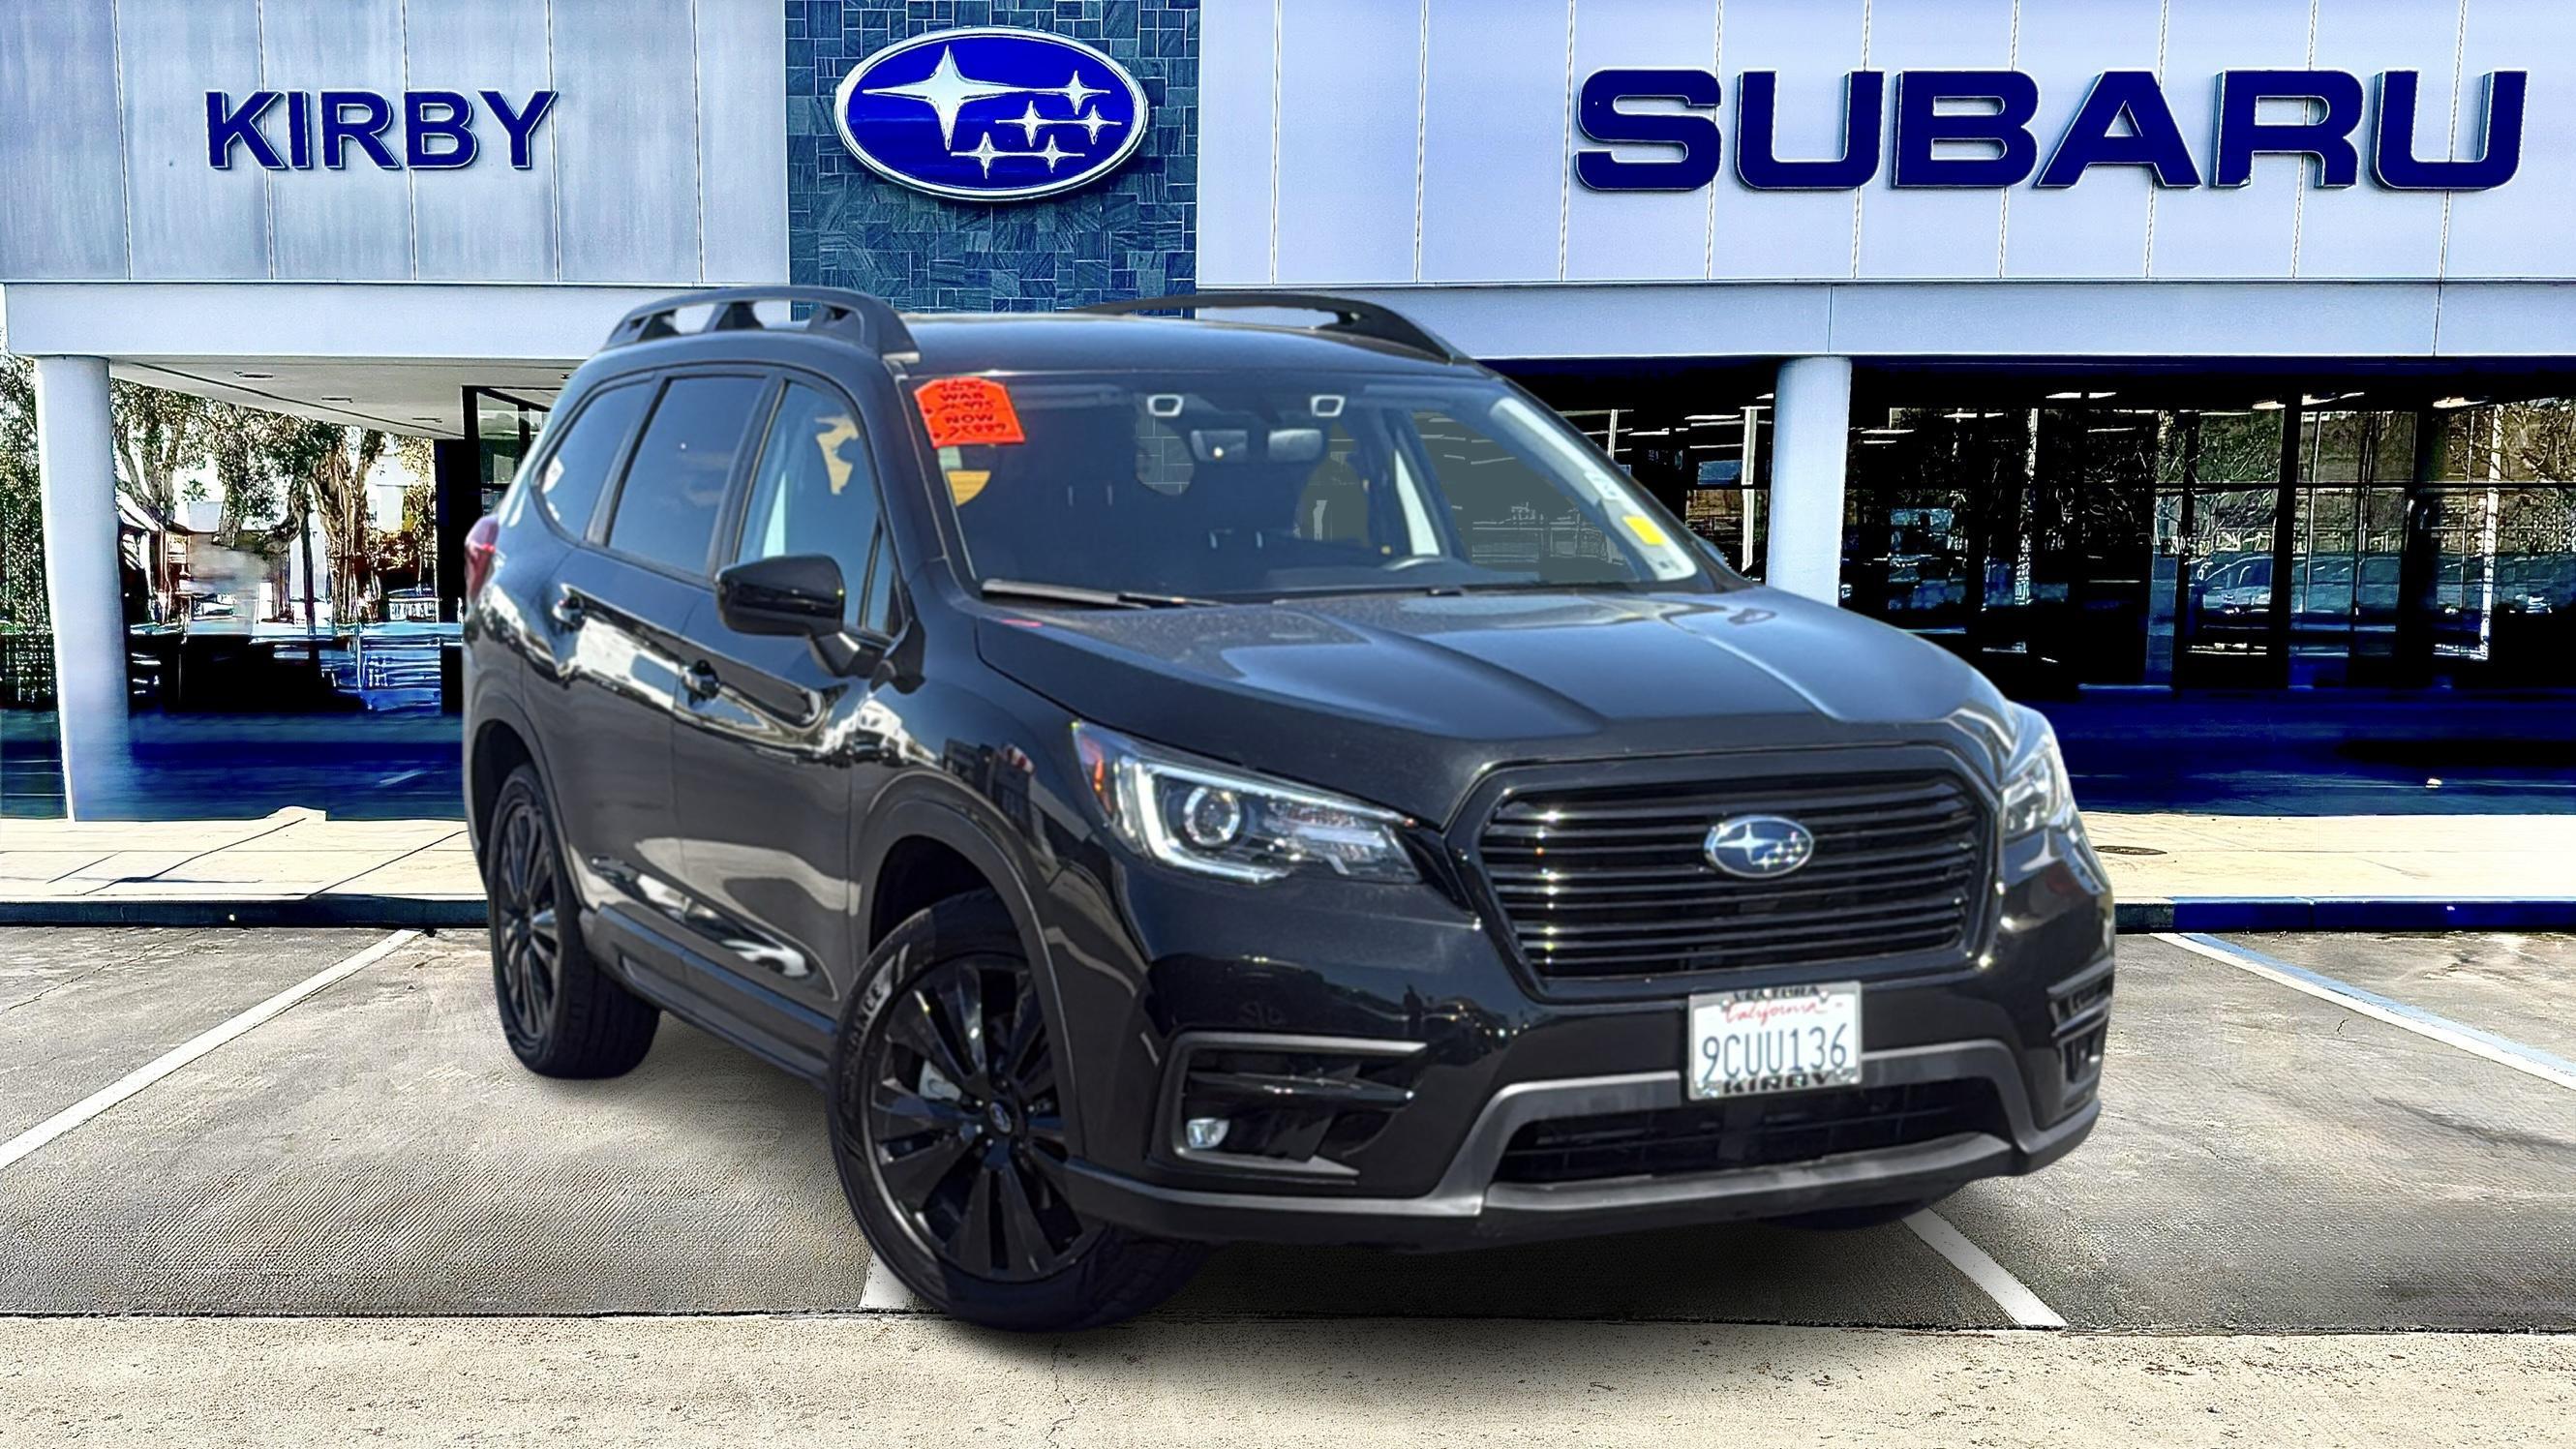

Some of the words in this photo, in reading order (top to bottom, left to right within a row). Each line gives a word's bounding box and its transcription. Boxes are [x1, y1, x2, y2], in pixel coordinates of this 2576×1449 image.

[204, 89, 559, 169] KIRBY
[1573, 68, 2527, 191] SUBARU
[945, 414, 994, 424] NOW
[1724, 1001, 1827, 1026] California
[1702, 1022, 1848, 1082] 9CUU136
[1723, 1072, 1833, 1095] KIRBY
